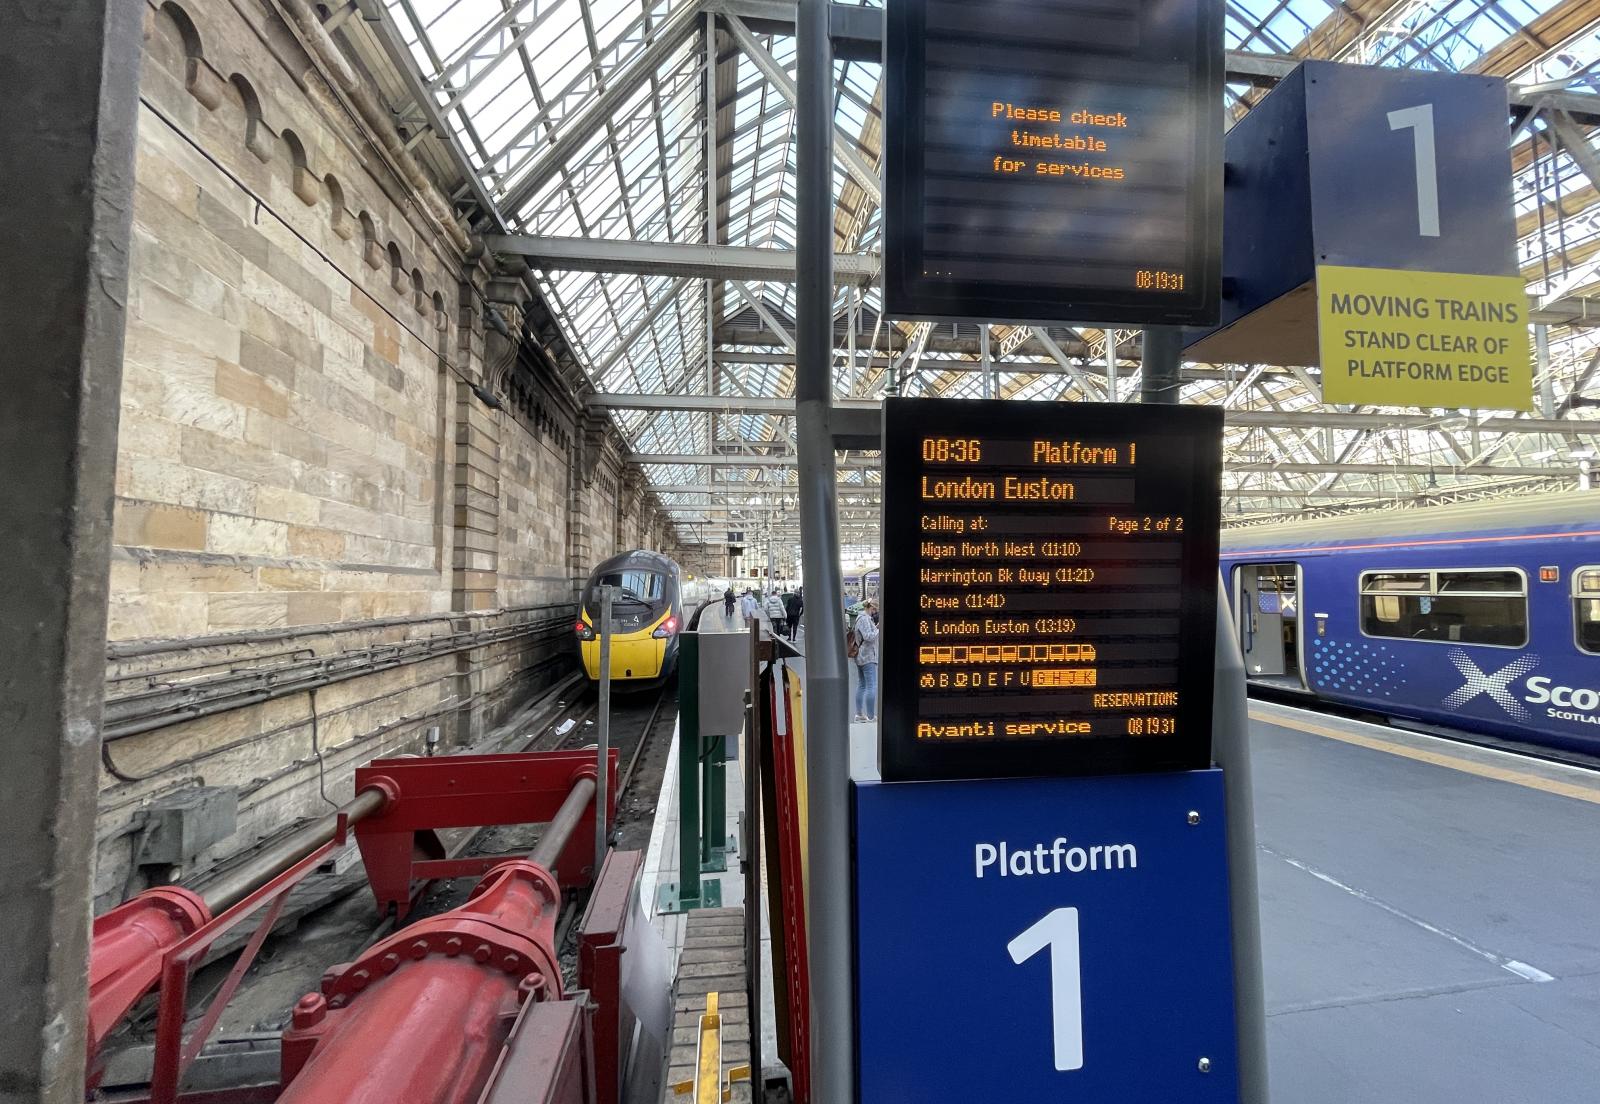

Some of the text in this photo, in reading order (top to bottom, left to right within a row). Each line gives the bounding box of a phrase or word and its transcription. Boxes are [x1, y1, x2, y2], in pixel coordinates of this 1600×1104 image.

[992, 103, 1127, 127] Please check
[1012, 131, 1106, 151] timetable
[994, 156, 1124, 179] for services
[1387, 104, 1440, 237] 1
[1136, 270, 1184, 289] 08:19:31
[1332, 294, 1518, 323] MOVING TRAINS
[1345, 330, 1508, 354] STAND CLEAR OF
[1348, 360, 1509, 383] PLATFORM EDGE
[923, 439, 1136, 464] 08:36 Platform 1
[922, 477, 1074, 499] London Euston
[922, 516, 1183, 533] Calling at: Page 2 of 2
[921, 543, 1081, 559] Wigan North West (11:10)
[921, 569, 1094, 586] Warrington Bk Quay (11:21)
[920, 594, 1005, 608] Crewe (11:41)
[920, 620, 1076, 635] & London Euston (13:19)
[939, 673, 948, 687] B
[972, 672, 980, 686] D
[988, 672, 997, 686] E
[1004, 672, 1013, 685] F
[1020, 671, 1029, 684] U
[1094, 691, 1178, 707] RESERVATIONS
[1547, 708, 1600, 724] SCOTLA
[918, 722, 994, 737] Avanti
[1006, 721, 1091, 734] service
[976, 838, 1136, 877] Platform
[1007, 907, 1083, 1070] 1
